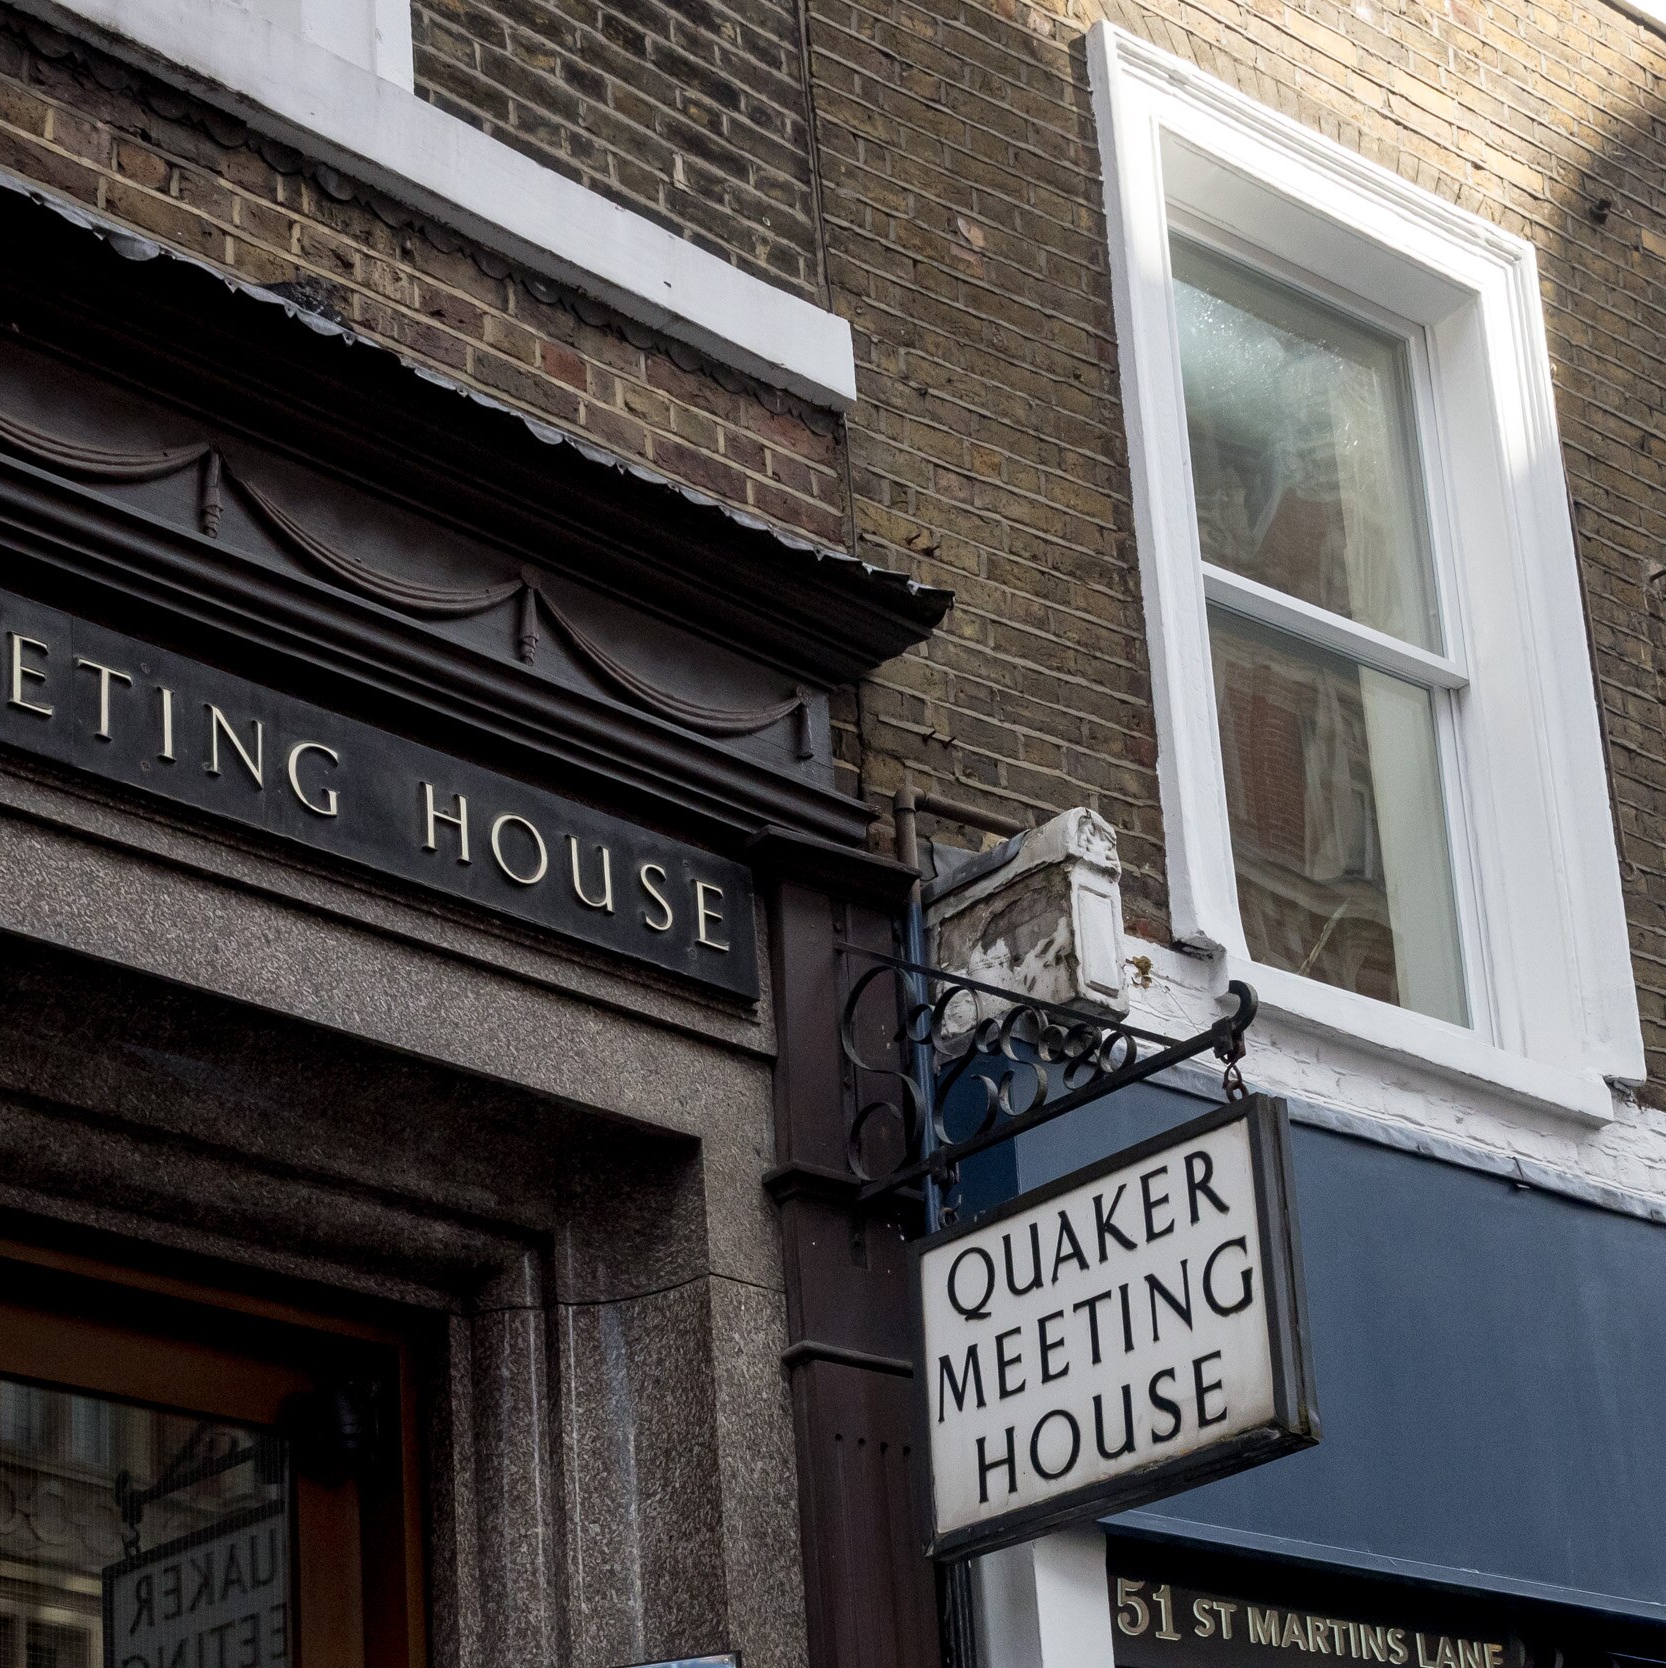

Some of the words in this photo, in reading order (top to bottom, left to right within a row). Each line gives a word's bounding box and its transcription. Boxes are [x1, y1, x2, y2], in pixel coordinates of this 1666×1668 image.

[419, 779, 732, 954] HOUSE
[946, 1150, 1230, 1321] QUAKER
[937, 1235, 1254, 1423] MEETING
[975, 1349, 1228, 1504] HOUSE
[1117, 1577, 1182, 1642] 51
[1193, 1598, 1236, 1640] ST
[1247, 1606, 1409, 1666] MARTINS
